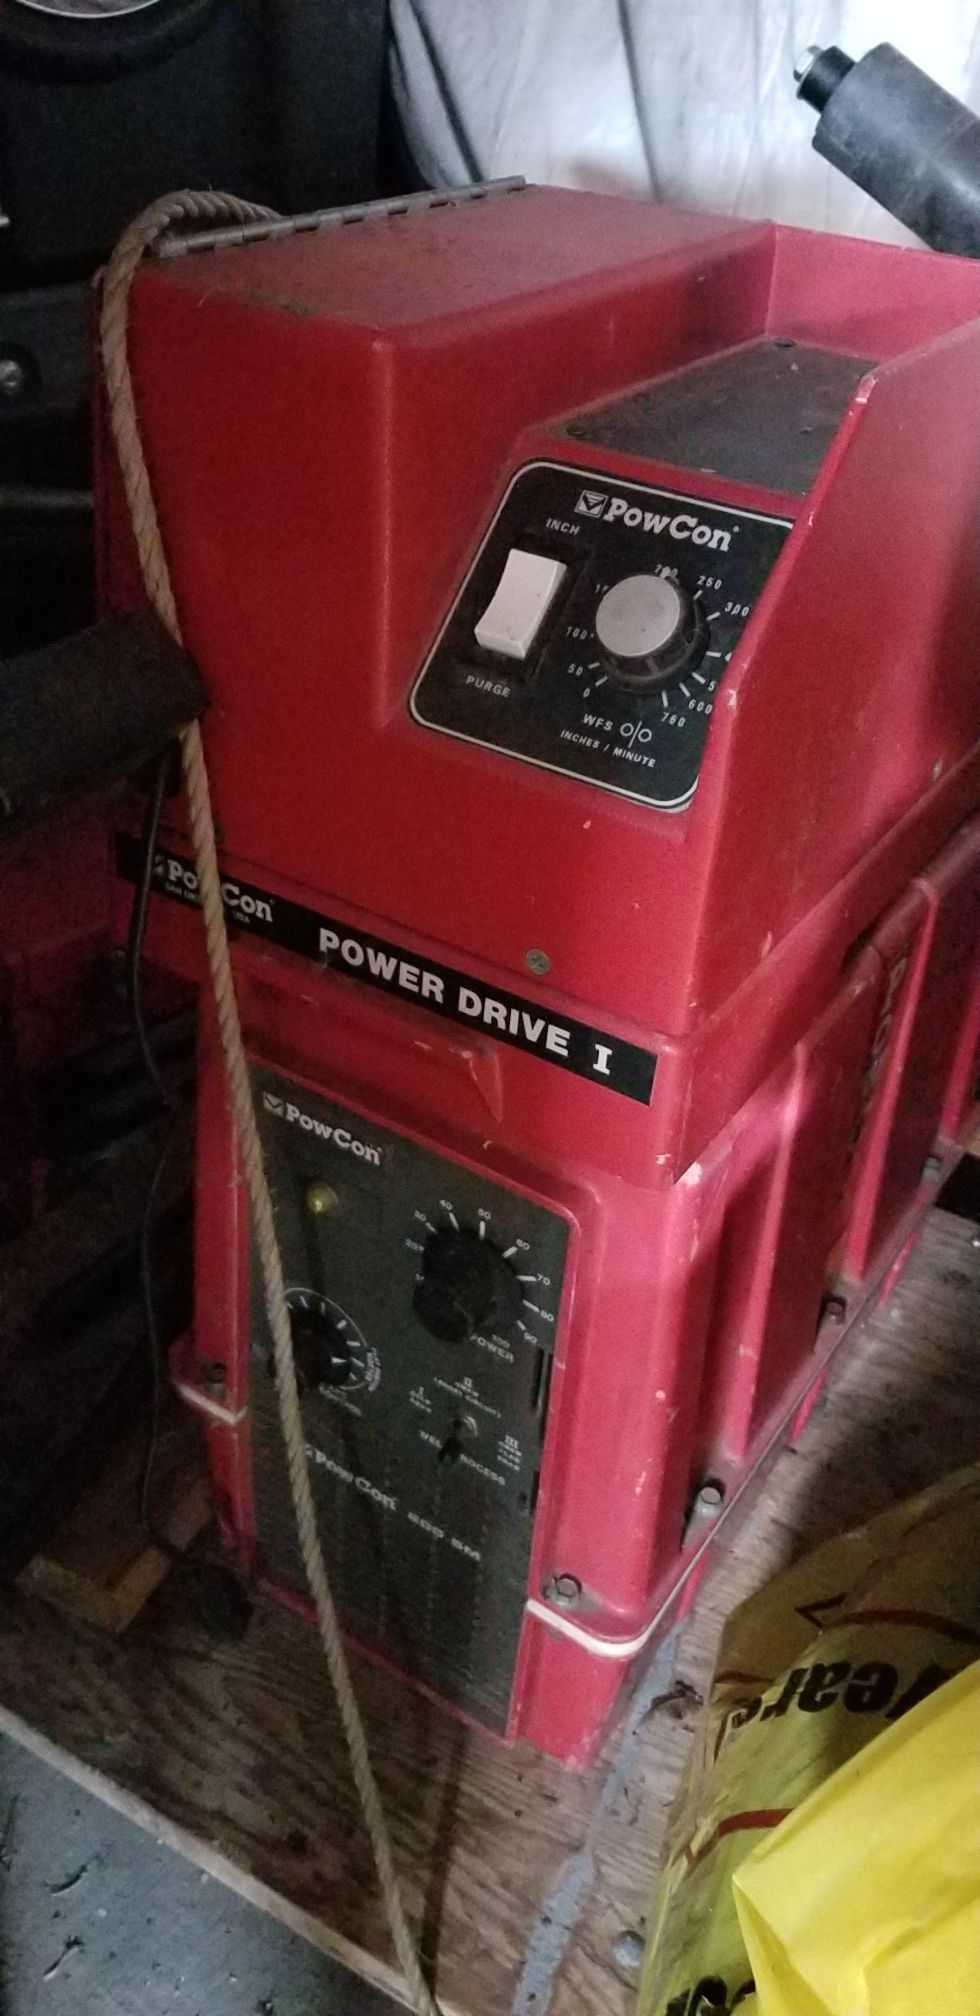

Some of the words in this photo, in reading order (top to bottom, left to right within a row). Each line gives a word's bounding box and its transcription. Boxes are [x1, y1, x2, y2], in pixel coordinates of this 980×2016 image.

[545, 517, 581, 536] INCH
[603, 498, 732, 552] PowCon
[725, 602, 749, 617] 300
[566, 626, 587, 640] 100
[567, 663, 583, 676] 50
[464, 674, 511, 698] PURGE
[582, 687, 590, 698] 0
[688, 699, 713, 715] 600
[582, 712, 614, 732] WFS
[560, 729, 600, 751] INCHES
[613, 747, 656, 769] MINUTE
[167, 859, 273, 922] PoCon
[319, 927, 446, 1004] POWER
[458, 986, 571, 1058] DRIVE
[592, 1043, 612, 1077] I
[284, 1102, 381, 1167] PowCon
[440, 1199, 453, 1211] 40
[537, 1273, 551, 1286] 70
[419, 1430, 442, 1449] WEL
[460, 1453, 506, 1486] ROCESS
